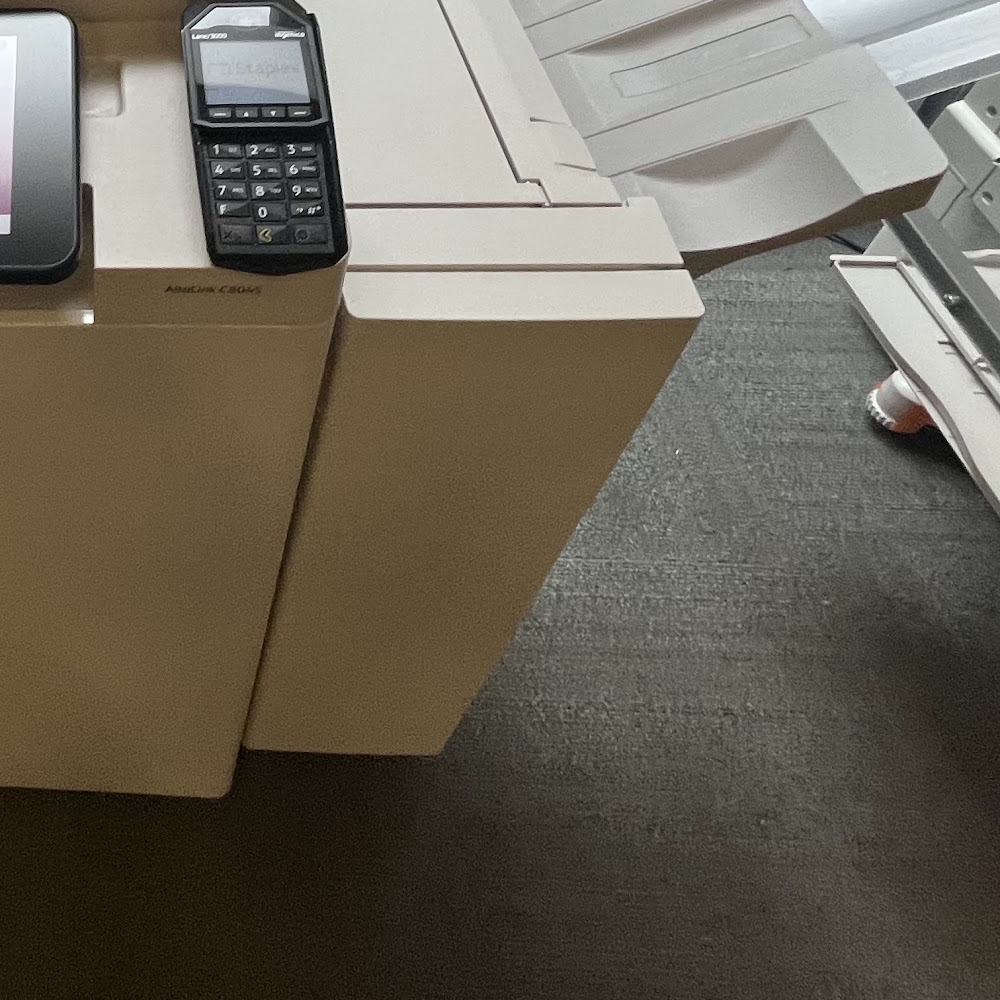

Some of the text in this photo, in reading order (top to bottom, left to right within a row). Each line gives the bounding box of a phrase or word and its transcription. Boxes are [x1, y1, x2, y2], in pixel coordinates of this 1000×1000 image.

[212, 144, 220, 155] 1
[249, 145, 259, 155] 2
[287, 144, 296, 155] 3
[215, 164, 224, 175] 4
[252, 165, 261, 176] 5
[289, 164, 299, 175] 6
[217, 185, 227, 196] 7
[255, 186, 265, 197] 8
[292, 185, 302, 196] 9
[219, 204, 227, 215] F
[258, 206, 268, 218] 0
